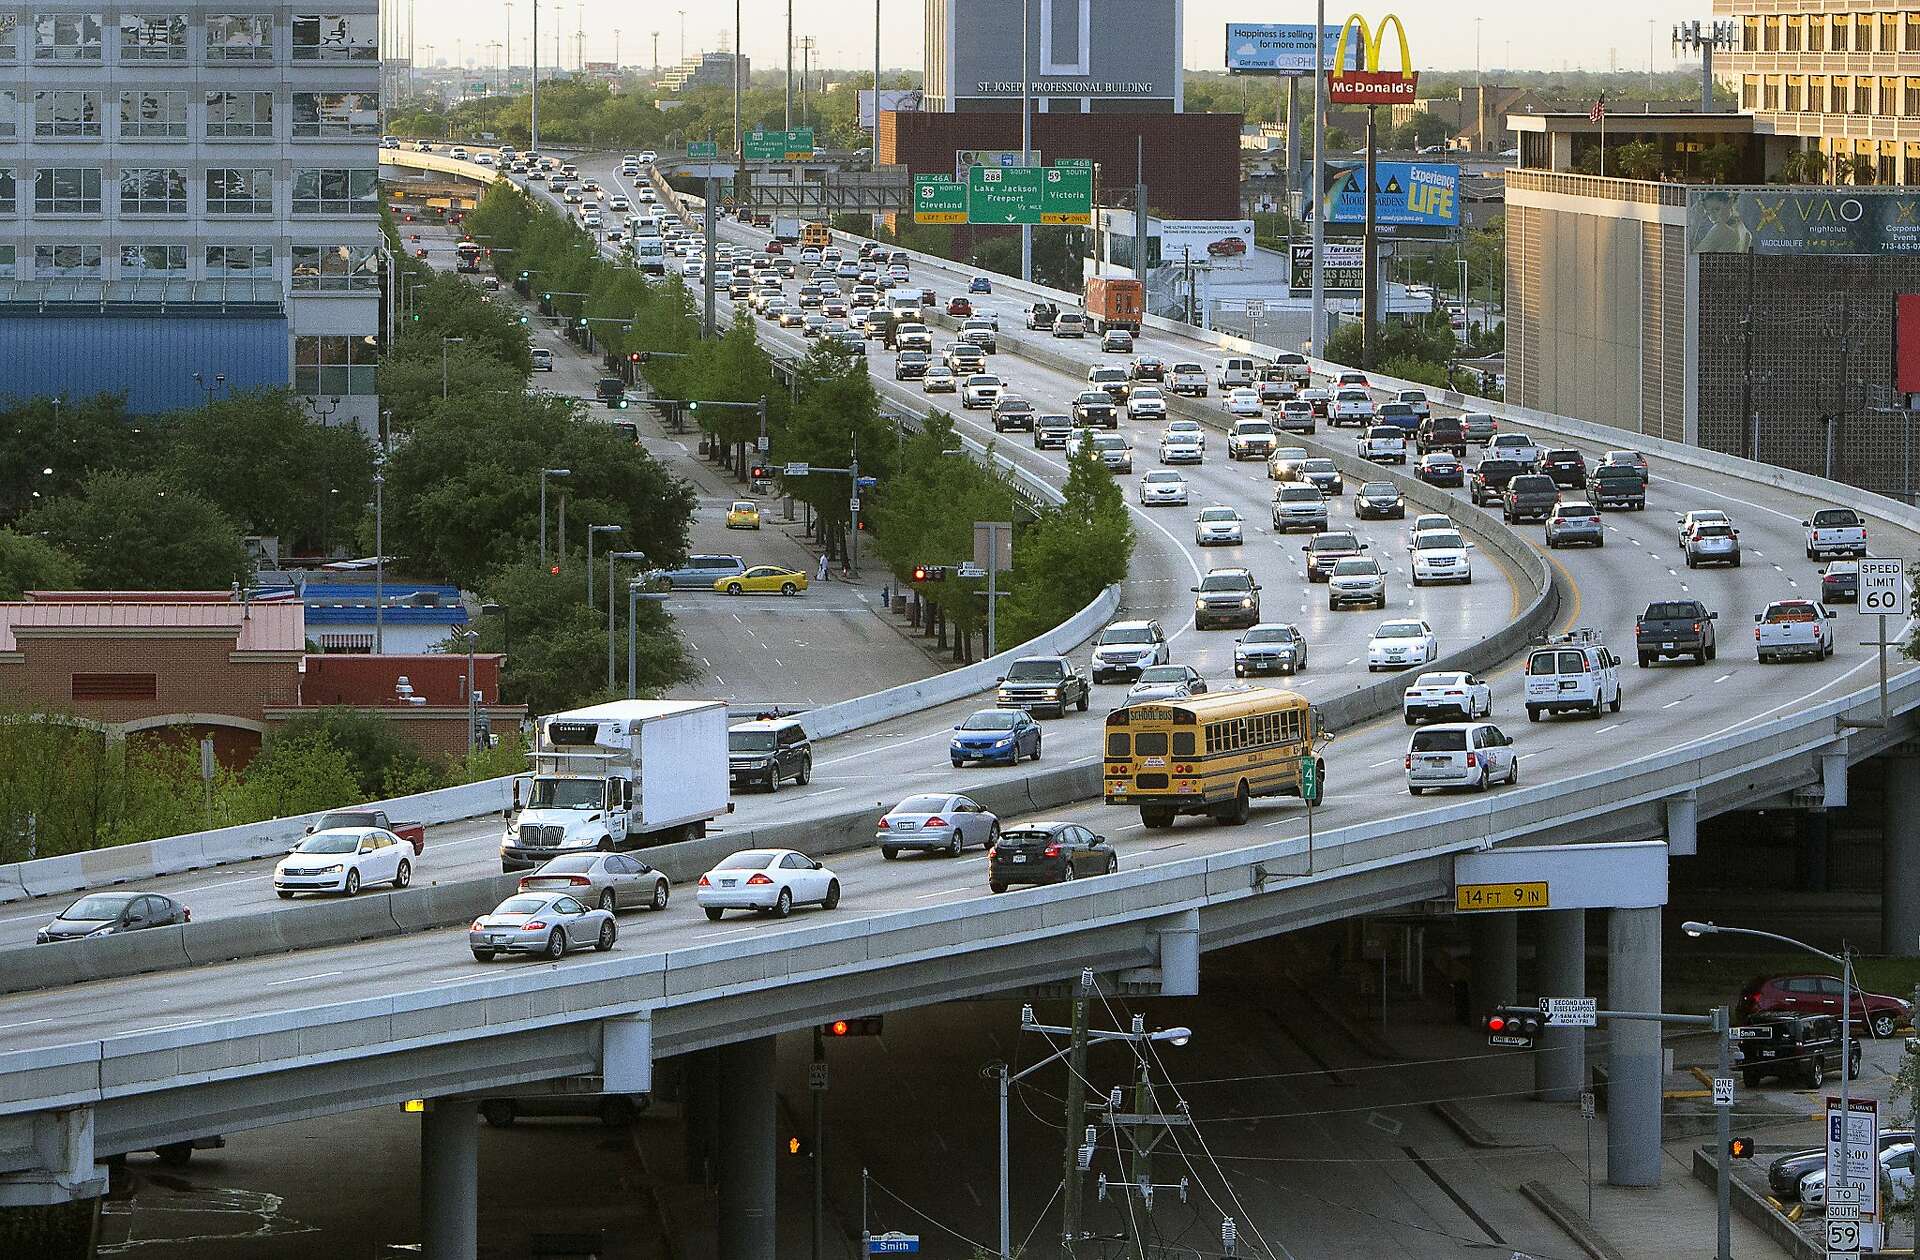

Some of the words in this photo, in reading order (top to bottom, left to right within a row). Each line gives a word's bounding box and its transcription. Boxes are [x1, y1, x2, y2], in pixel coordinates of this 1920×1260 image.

[1234, 29, 1277, 39] Happiness
[1279, 30, 1286, 38] is
[1288, 30, 1313, 40] selling
[1260, 40, 1270, 48] for
[978, 82, 991, 92] ST.
[1031, 82, 1102, 92] PROFESSIONAL
[1105, 82, 1152, 92] BUILDING
[1332, 82, 1414, 94] McDonald's
[1048, 172, 1060, 180] 59
[1410, 166, 1455, 188] Experience
[923, 188, 934, 196] 59
[1002, 185, 1037, 193] Jackson
[1050, 191, 1085, 199] Victoria
[1408, 182, 1454, 218] LIFE
[920, 201, 962, 209] Cleveland
[1376, 196, 1405, 207] ARDENS
[1796, 199, 1863, 222] VAO
[1809, 225, 1847, 233] nightclub
[1893, 233, 1917, 241] Events
[1862, 564, 1900, 574] SPEED
[1866, 577, 1896, 587] LIMIT
[1866, 591, 1896, 608] 60
[1130, 710, 1157, 720] SCHOOL
[1159, 710, 1173, 720] BUS
[1466, 890, 1482, 905] 14
[1487, 892, 1501, 904] FT
[1514, 888, 1523, 902] 9
[1528, 891, 1539, 902] IN
[1836, 1190, 1851, 1199] TO
[1829, 1206, 1858, 1216] SOUTH
[1831, 1227, 1856, 1244] 59
[880, 1241, 909, 1251] Smith
